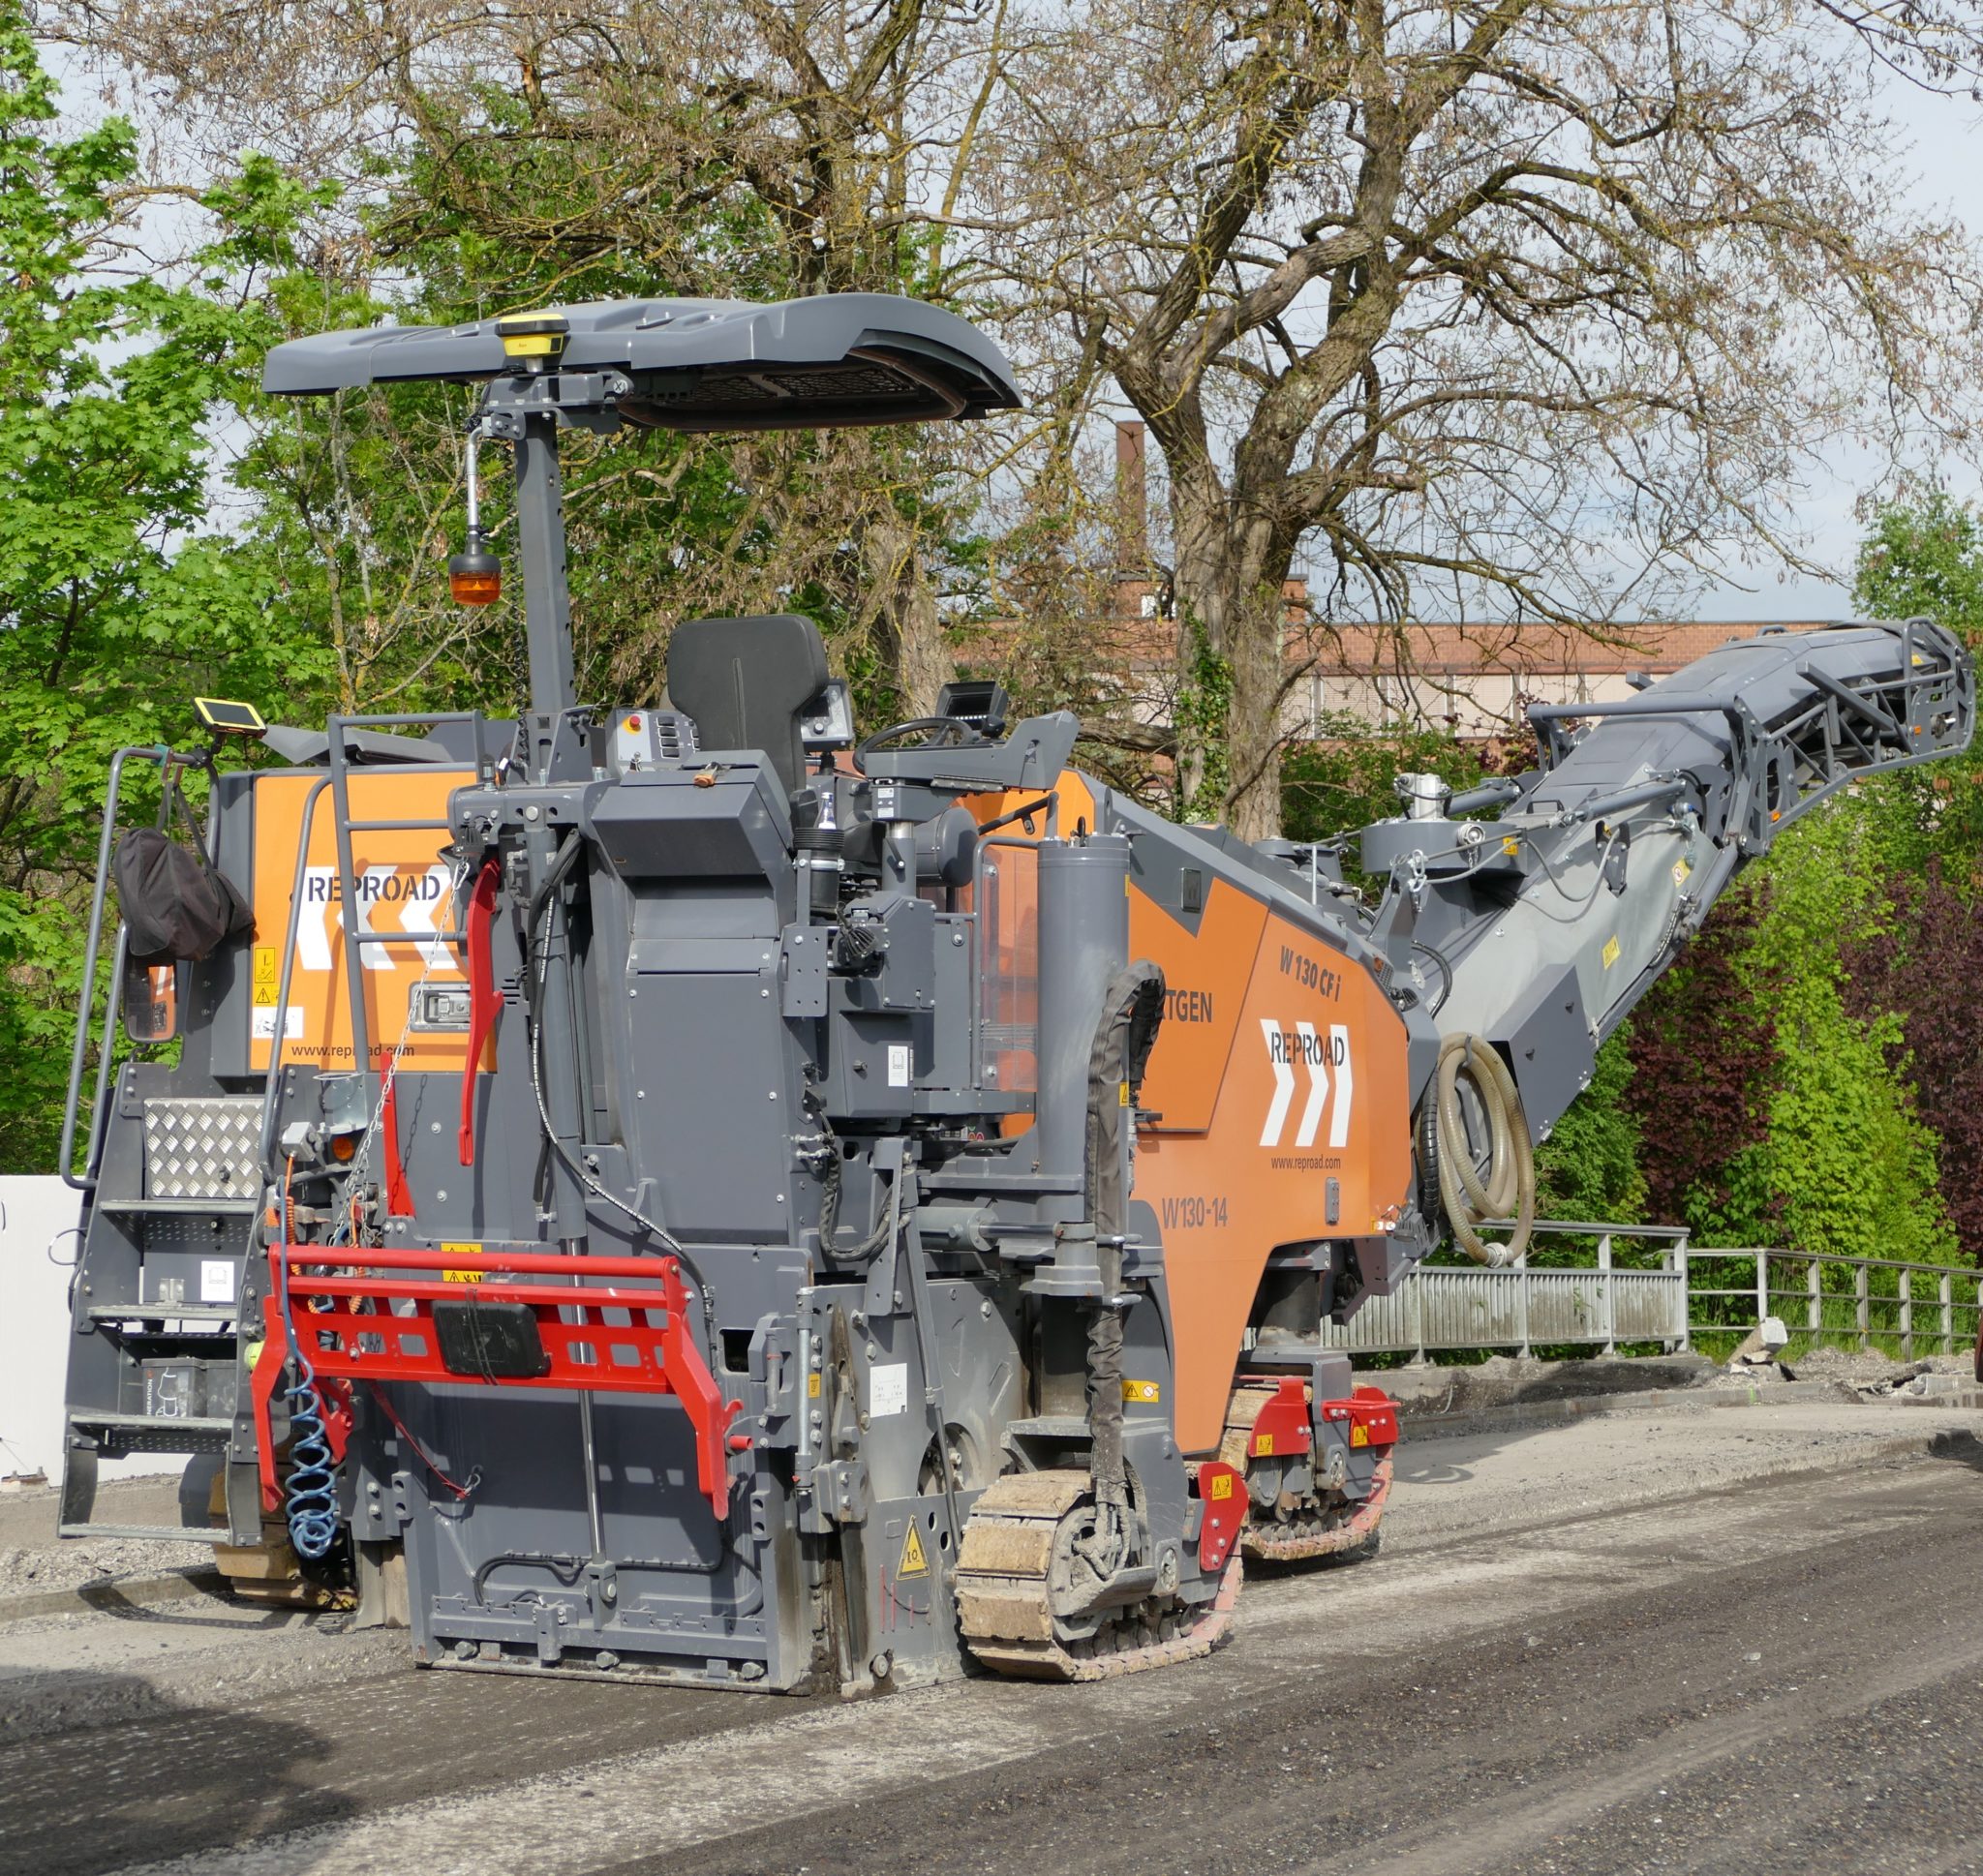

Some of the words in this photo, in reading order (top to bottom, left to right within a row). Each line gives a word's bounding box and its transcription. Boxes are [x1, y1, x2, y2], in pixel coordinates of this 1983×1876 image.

[1280, 945, 1294, 975] W
[1296, 954, 1318, 989] 130
[1163, 989, 1212, 1023] TGEN
[291, 1044, 415, 1059] www.repadcom
[1271, 1032, 1345, 1067] REPROAD
[1270, 1154, 1341, 1172] www.reproad.com
[1162, 1196, 1228, 1229] W130-14
